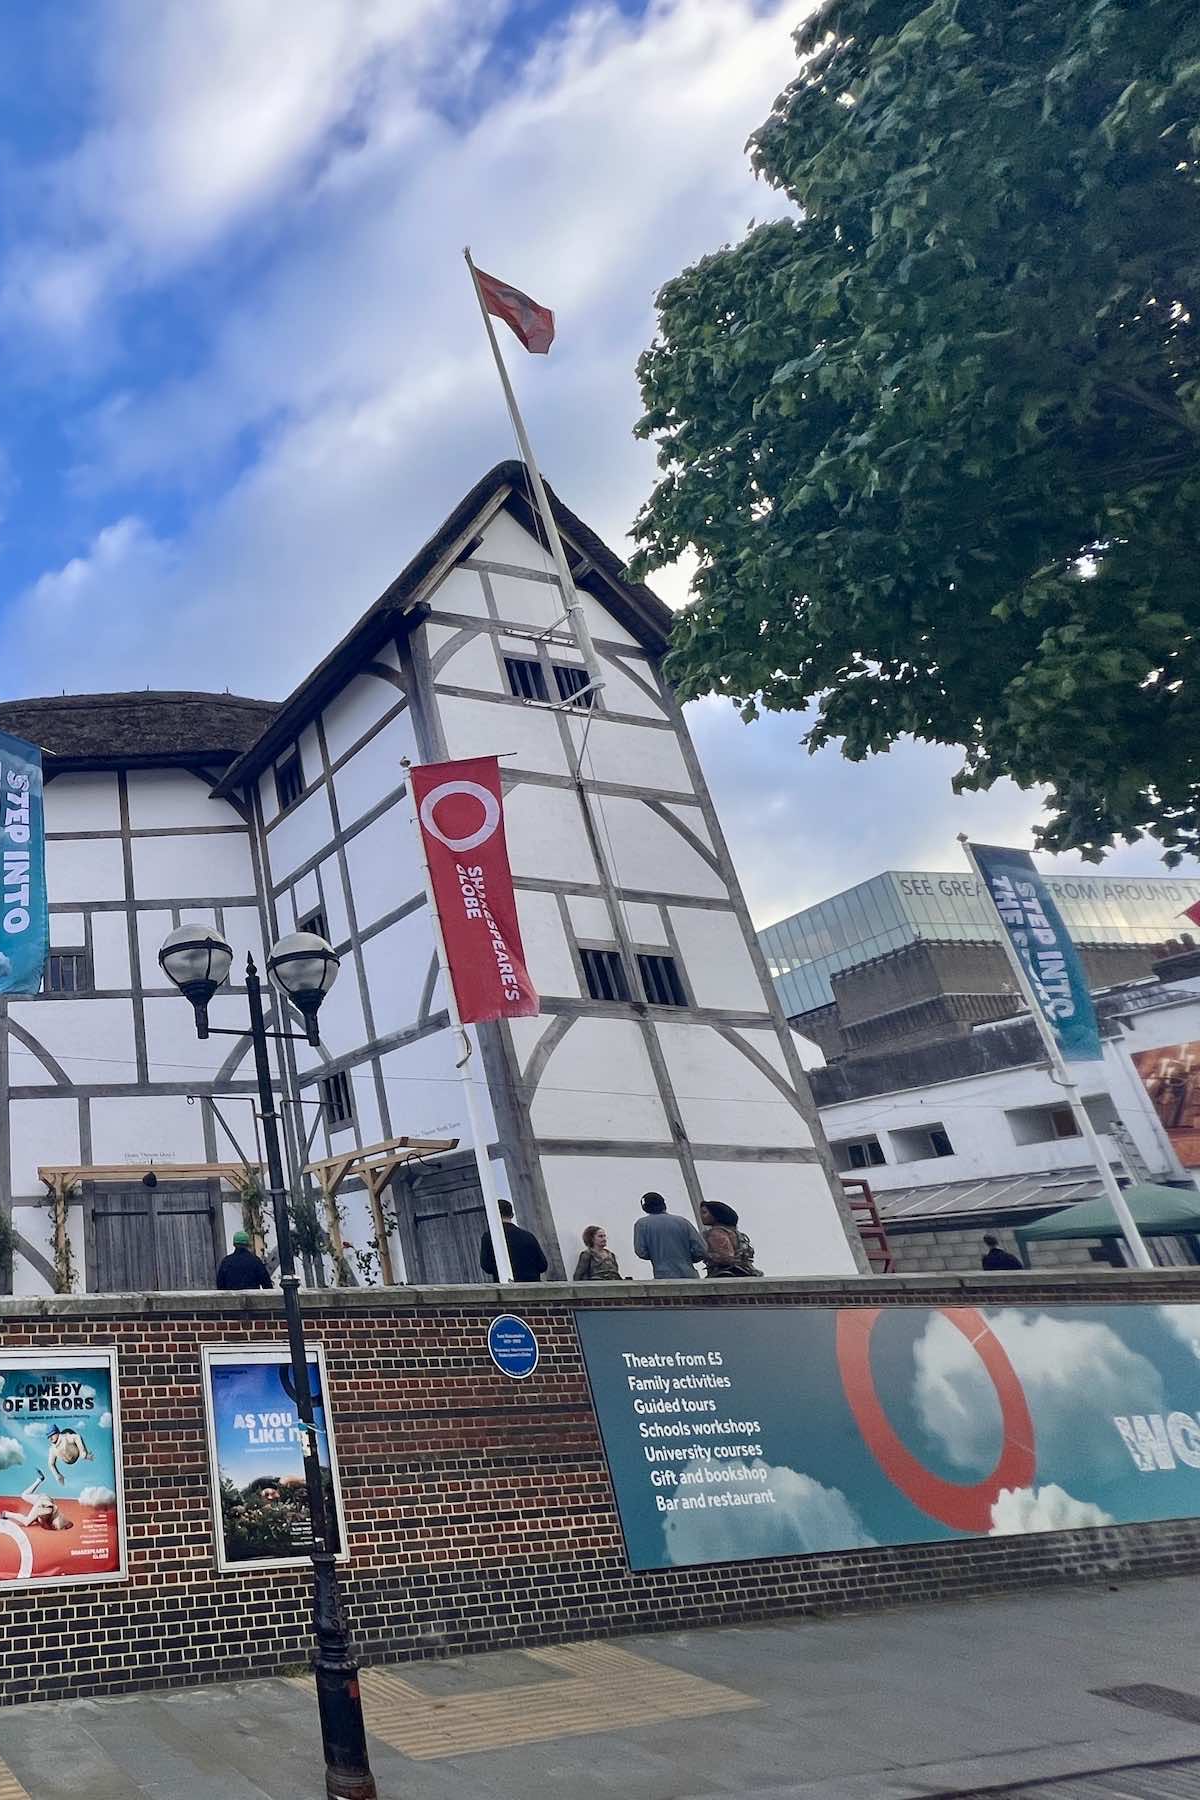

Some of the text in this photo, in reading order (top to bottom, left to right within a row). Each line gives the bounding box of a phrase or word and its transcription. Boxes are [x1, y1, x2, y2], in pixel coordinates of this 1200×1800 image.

[3, 770, 31, 934] STEP INTO
[455, 863, 483, 920] GLOBE
[901, 880, 934, 896] SEE
[1104, 884, 1182, 901] AROUND
[992, 875, 1025, 925] THE
[1014, 881, 1057, 946] STEP
[467, 865, 520, 1001] SHAKESPEARE'S
[622, 1351, 723, 1368] Theatre from £5
[41, 1375, 57, 1383] THE
[627, 1373, 732, 1394] Family activities
[15, 1383, 82, 1398] COMEDY
[3, 1397, 95, 1412] OF ERRORS
[633, 1398, 717, 1415] Guided tours
[233, 1412, 292, 1429] AS YOU
[639, 1419, 761, 1438] Schools workshops
[248, 1428, 286, 1443] LIKE
[1113, 1411, 1200, 1472] WO
[643, 1444, 763, 1463] University courses
[650, 1464, 768, 1487] Gift and bookshop
[655, 1489, 777, 1512] Bar and restaurant
